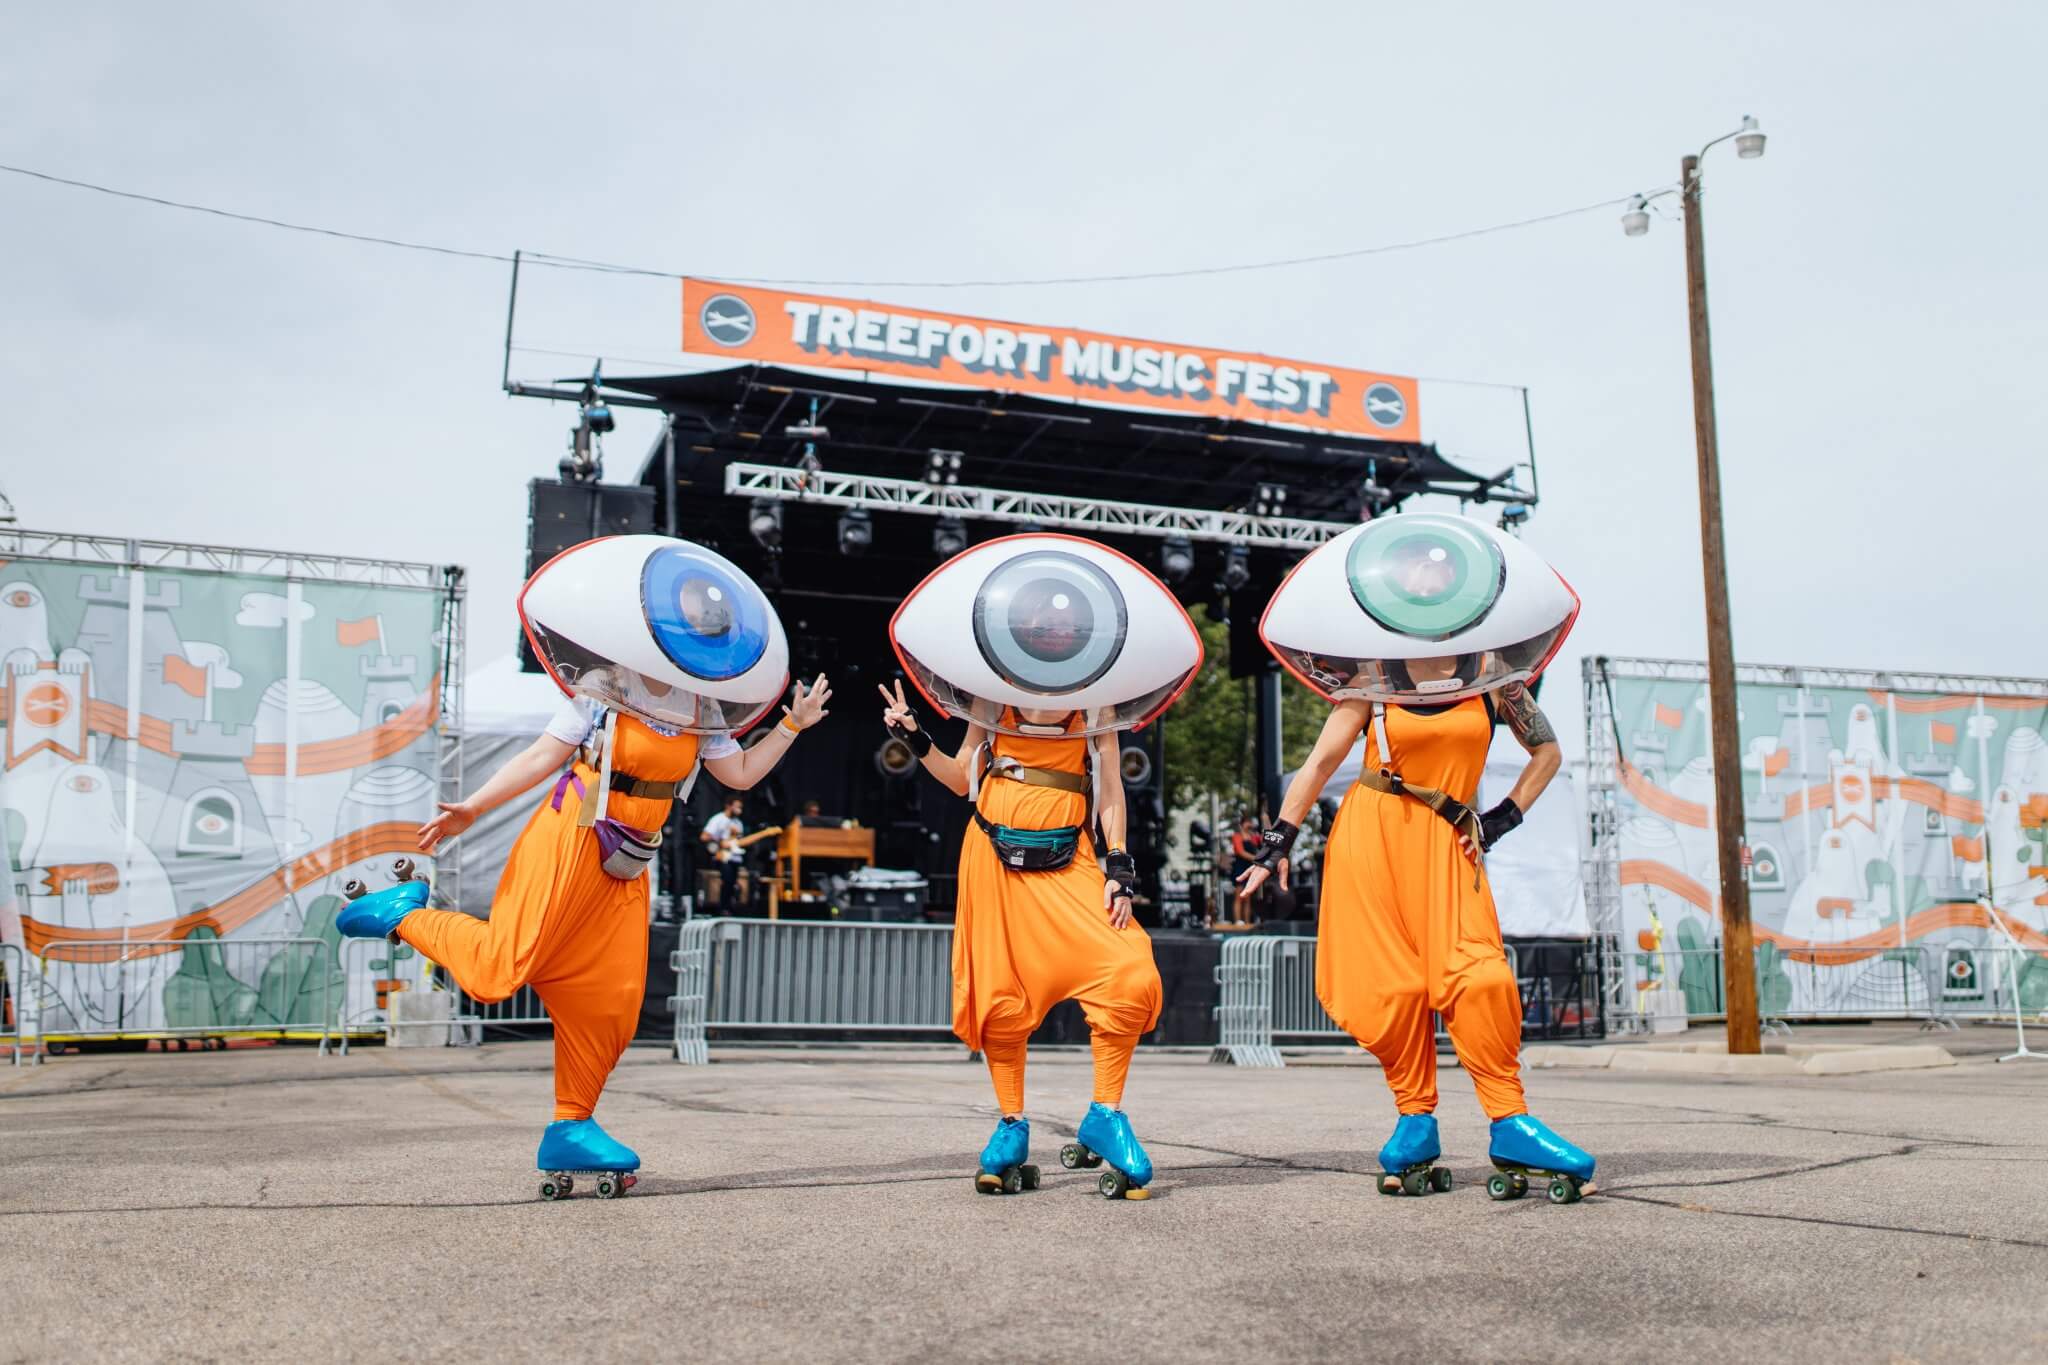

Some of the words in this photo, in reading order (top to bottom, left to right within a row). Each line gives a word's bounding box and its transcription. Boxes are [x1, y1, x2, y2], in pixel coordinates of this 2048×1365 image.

[784, 300, 1054, 373] TREEFORT
[1061, 337, 1207, 395] MUSIC
[1215, 357, 1332, 410] FEST
